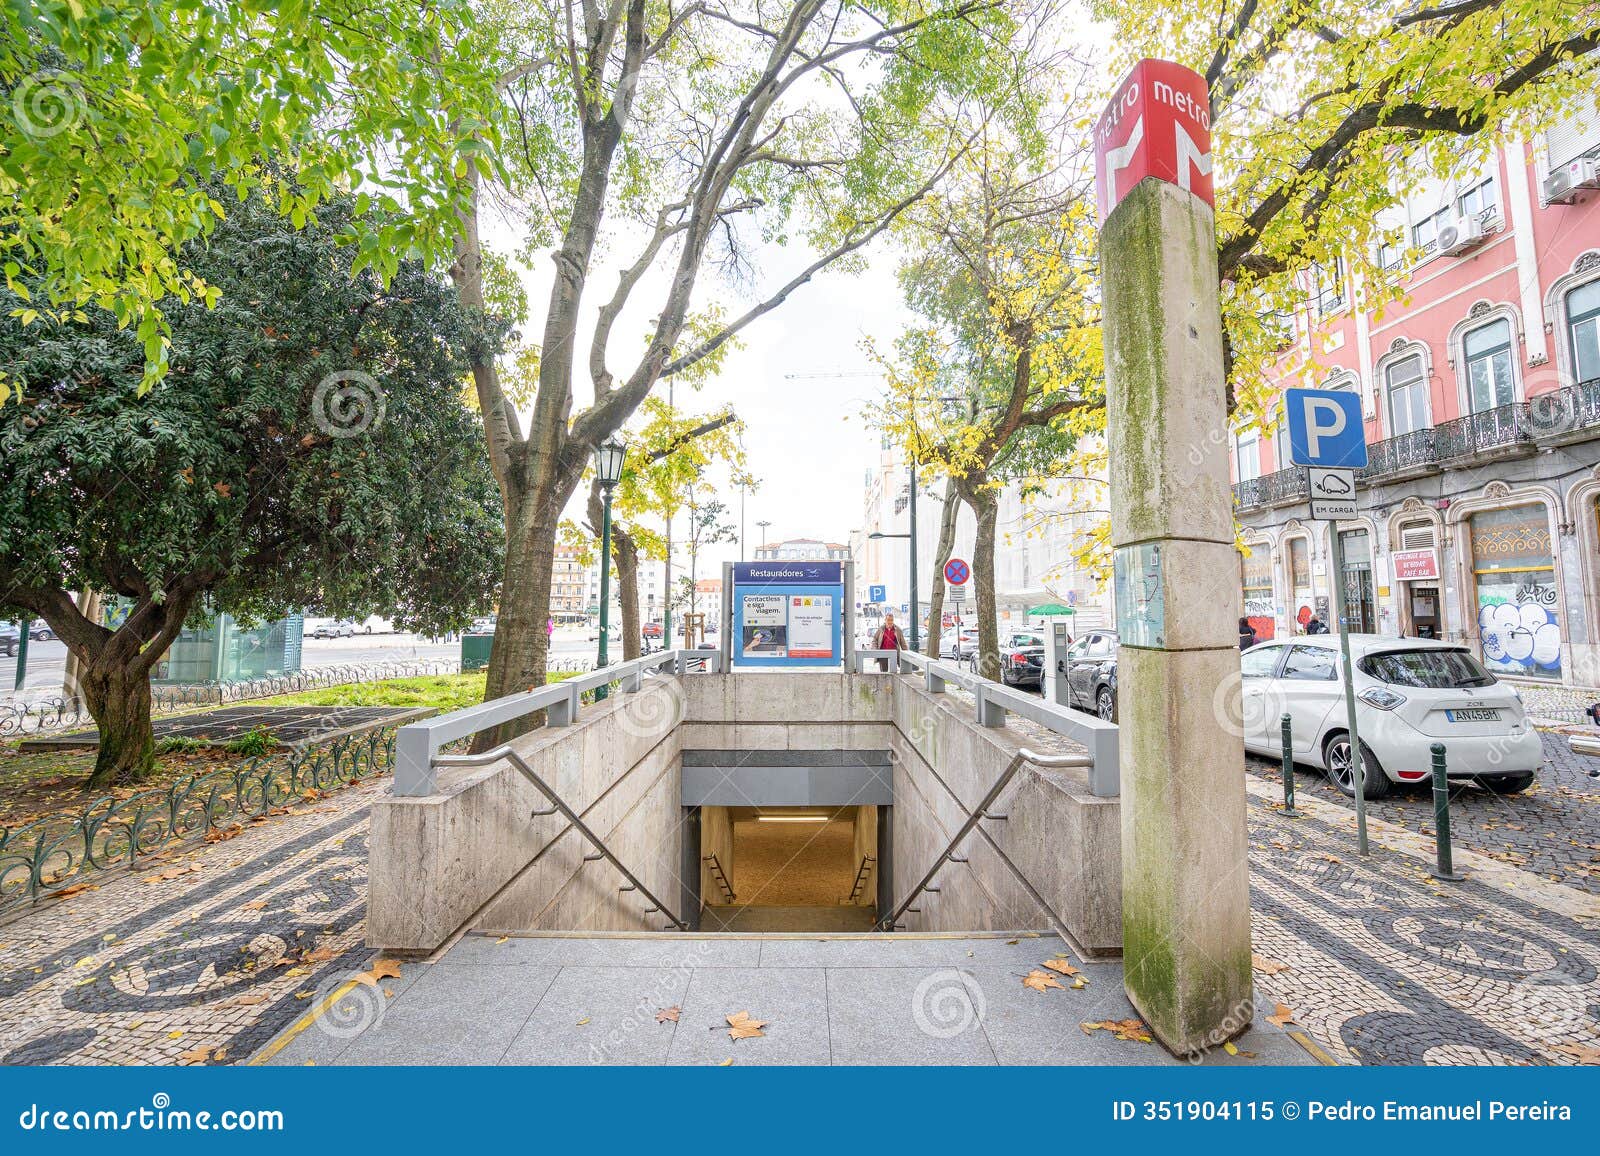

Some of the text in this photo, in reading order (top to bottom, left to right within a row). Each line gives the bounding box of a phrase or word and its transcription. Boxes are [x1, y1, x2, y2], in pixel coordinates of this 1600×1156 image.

[1153, 81, 1211, 131] metro
[1303, 396, 1347, 458] P
[750, 568, 804, 578] Restauradores
[873, 587, 882, 601] P
